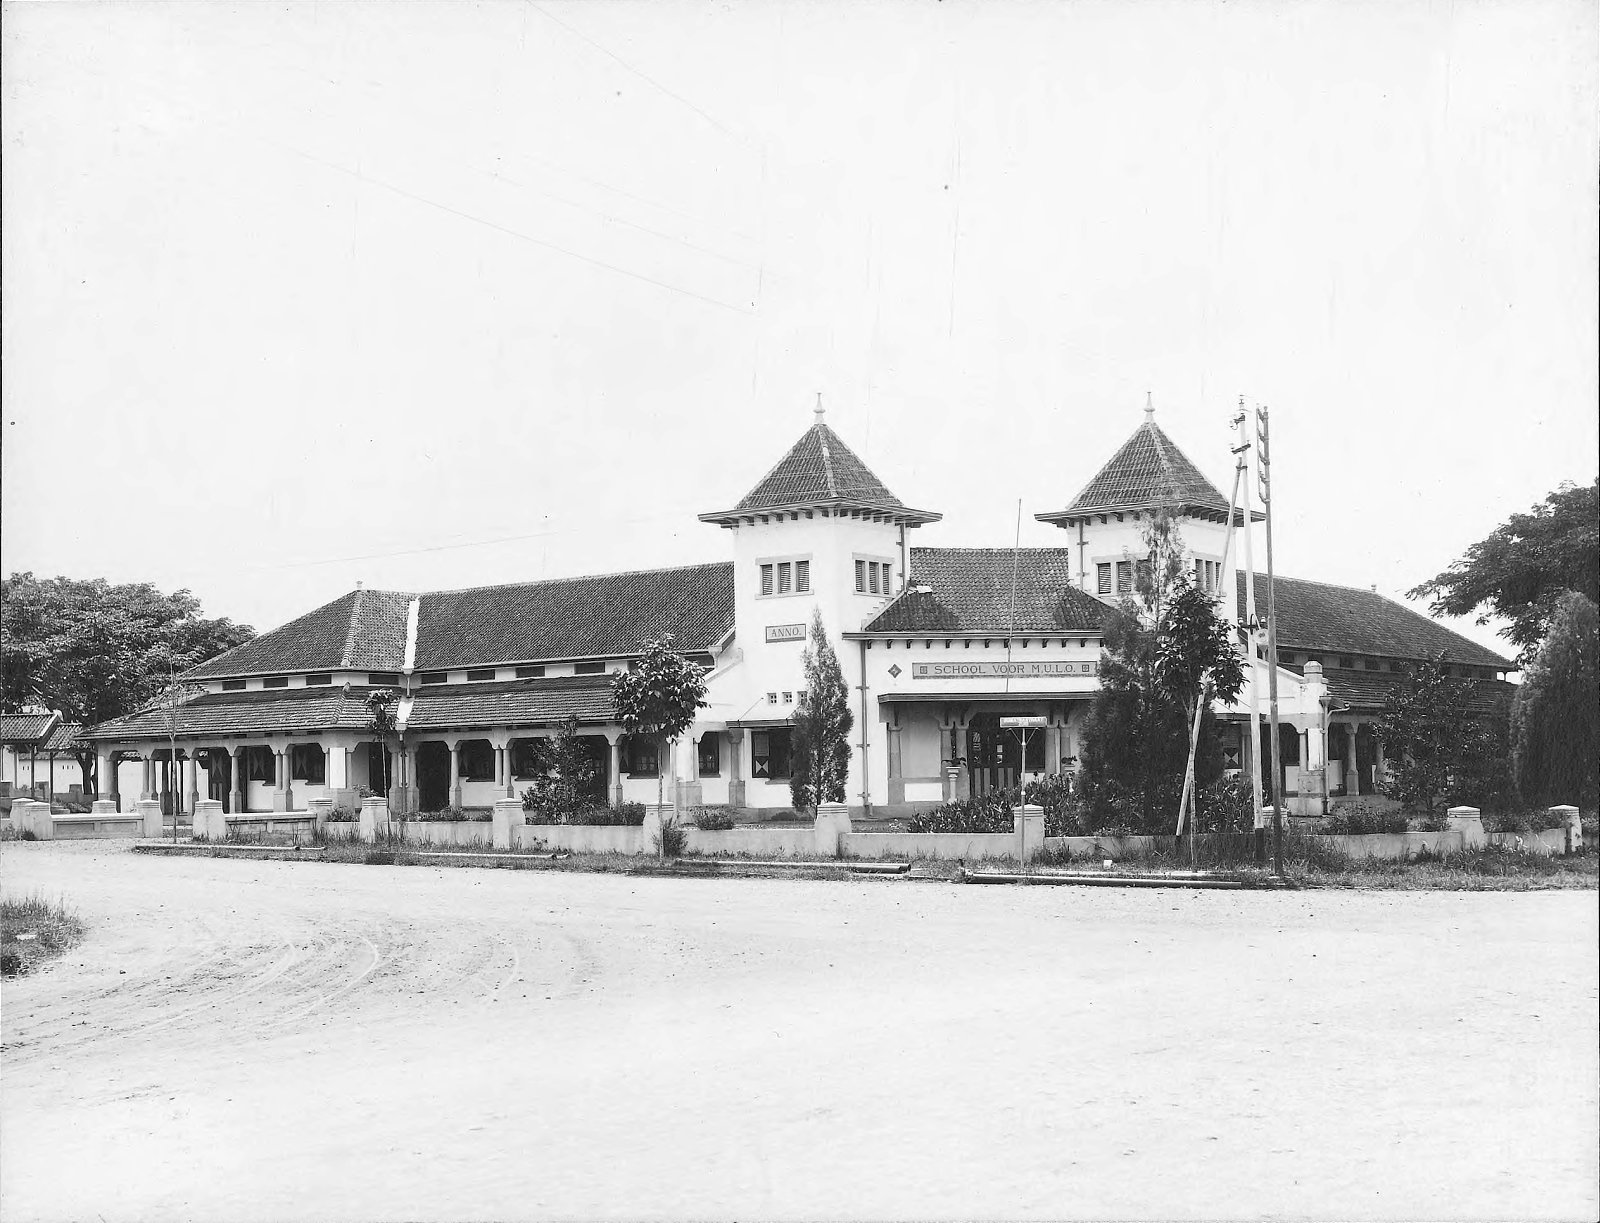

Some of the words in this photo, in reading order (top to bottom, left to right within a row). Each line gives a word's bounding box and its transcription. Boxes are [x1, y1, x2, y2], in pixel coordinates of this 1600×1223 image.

[934, 665, 986, 675] SCHOOL
[992, 664, 1025, 674] VOOR
[1031, 664, 1076, 674] M.U.L.O.
